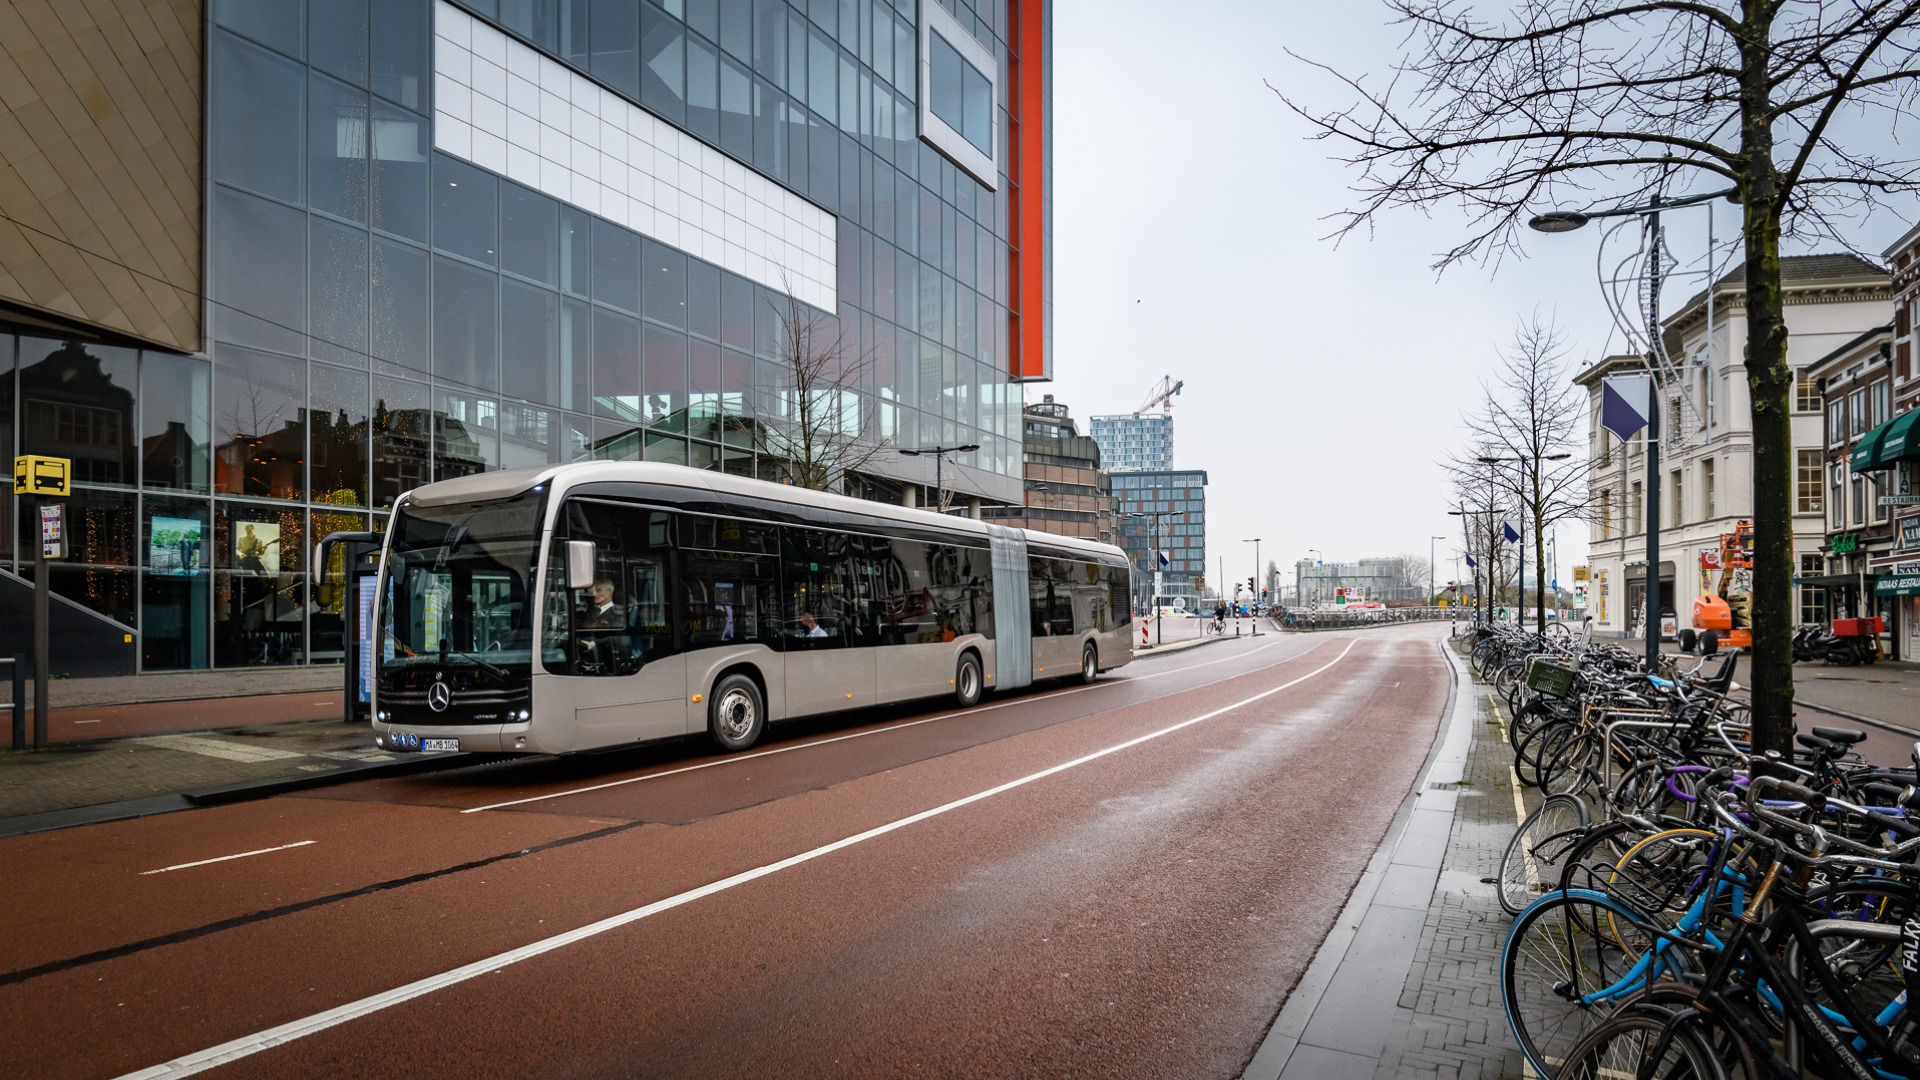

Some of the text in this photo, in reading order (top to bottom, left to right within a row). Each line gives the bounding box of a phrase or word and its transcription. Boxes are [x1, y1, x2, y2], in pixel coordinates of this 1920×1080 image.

[1900, 461, 1910, 493] NDIAN
[1882, 496, 1920, 504] RESTAURA
[1902, 518, 1919, 528] INDIAN
[1877, 580, 1898, 590] INDIAAS
[444, 739, 458, 750] 1064
